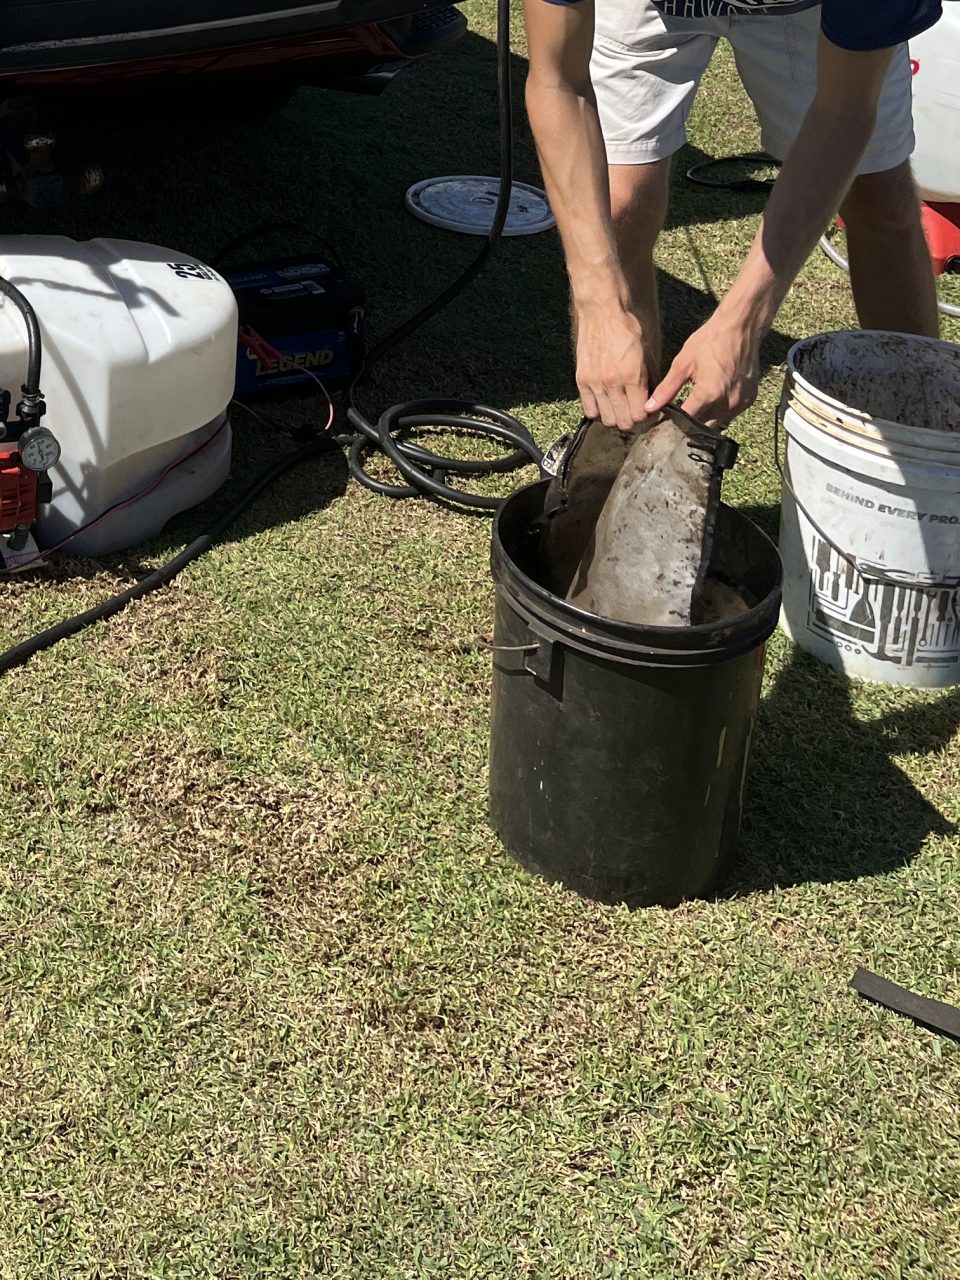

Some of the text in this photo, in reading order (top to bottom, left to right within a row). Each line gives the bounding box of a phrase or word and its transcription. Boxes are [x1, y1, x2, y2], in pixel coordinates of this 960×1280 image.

[825, 482, 960, 525] BEHIND EVERY PRO
